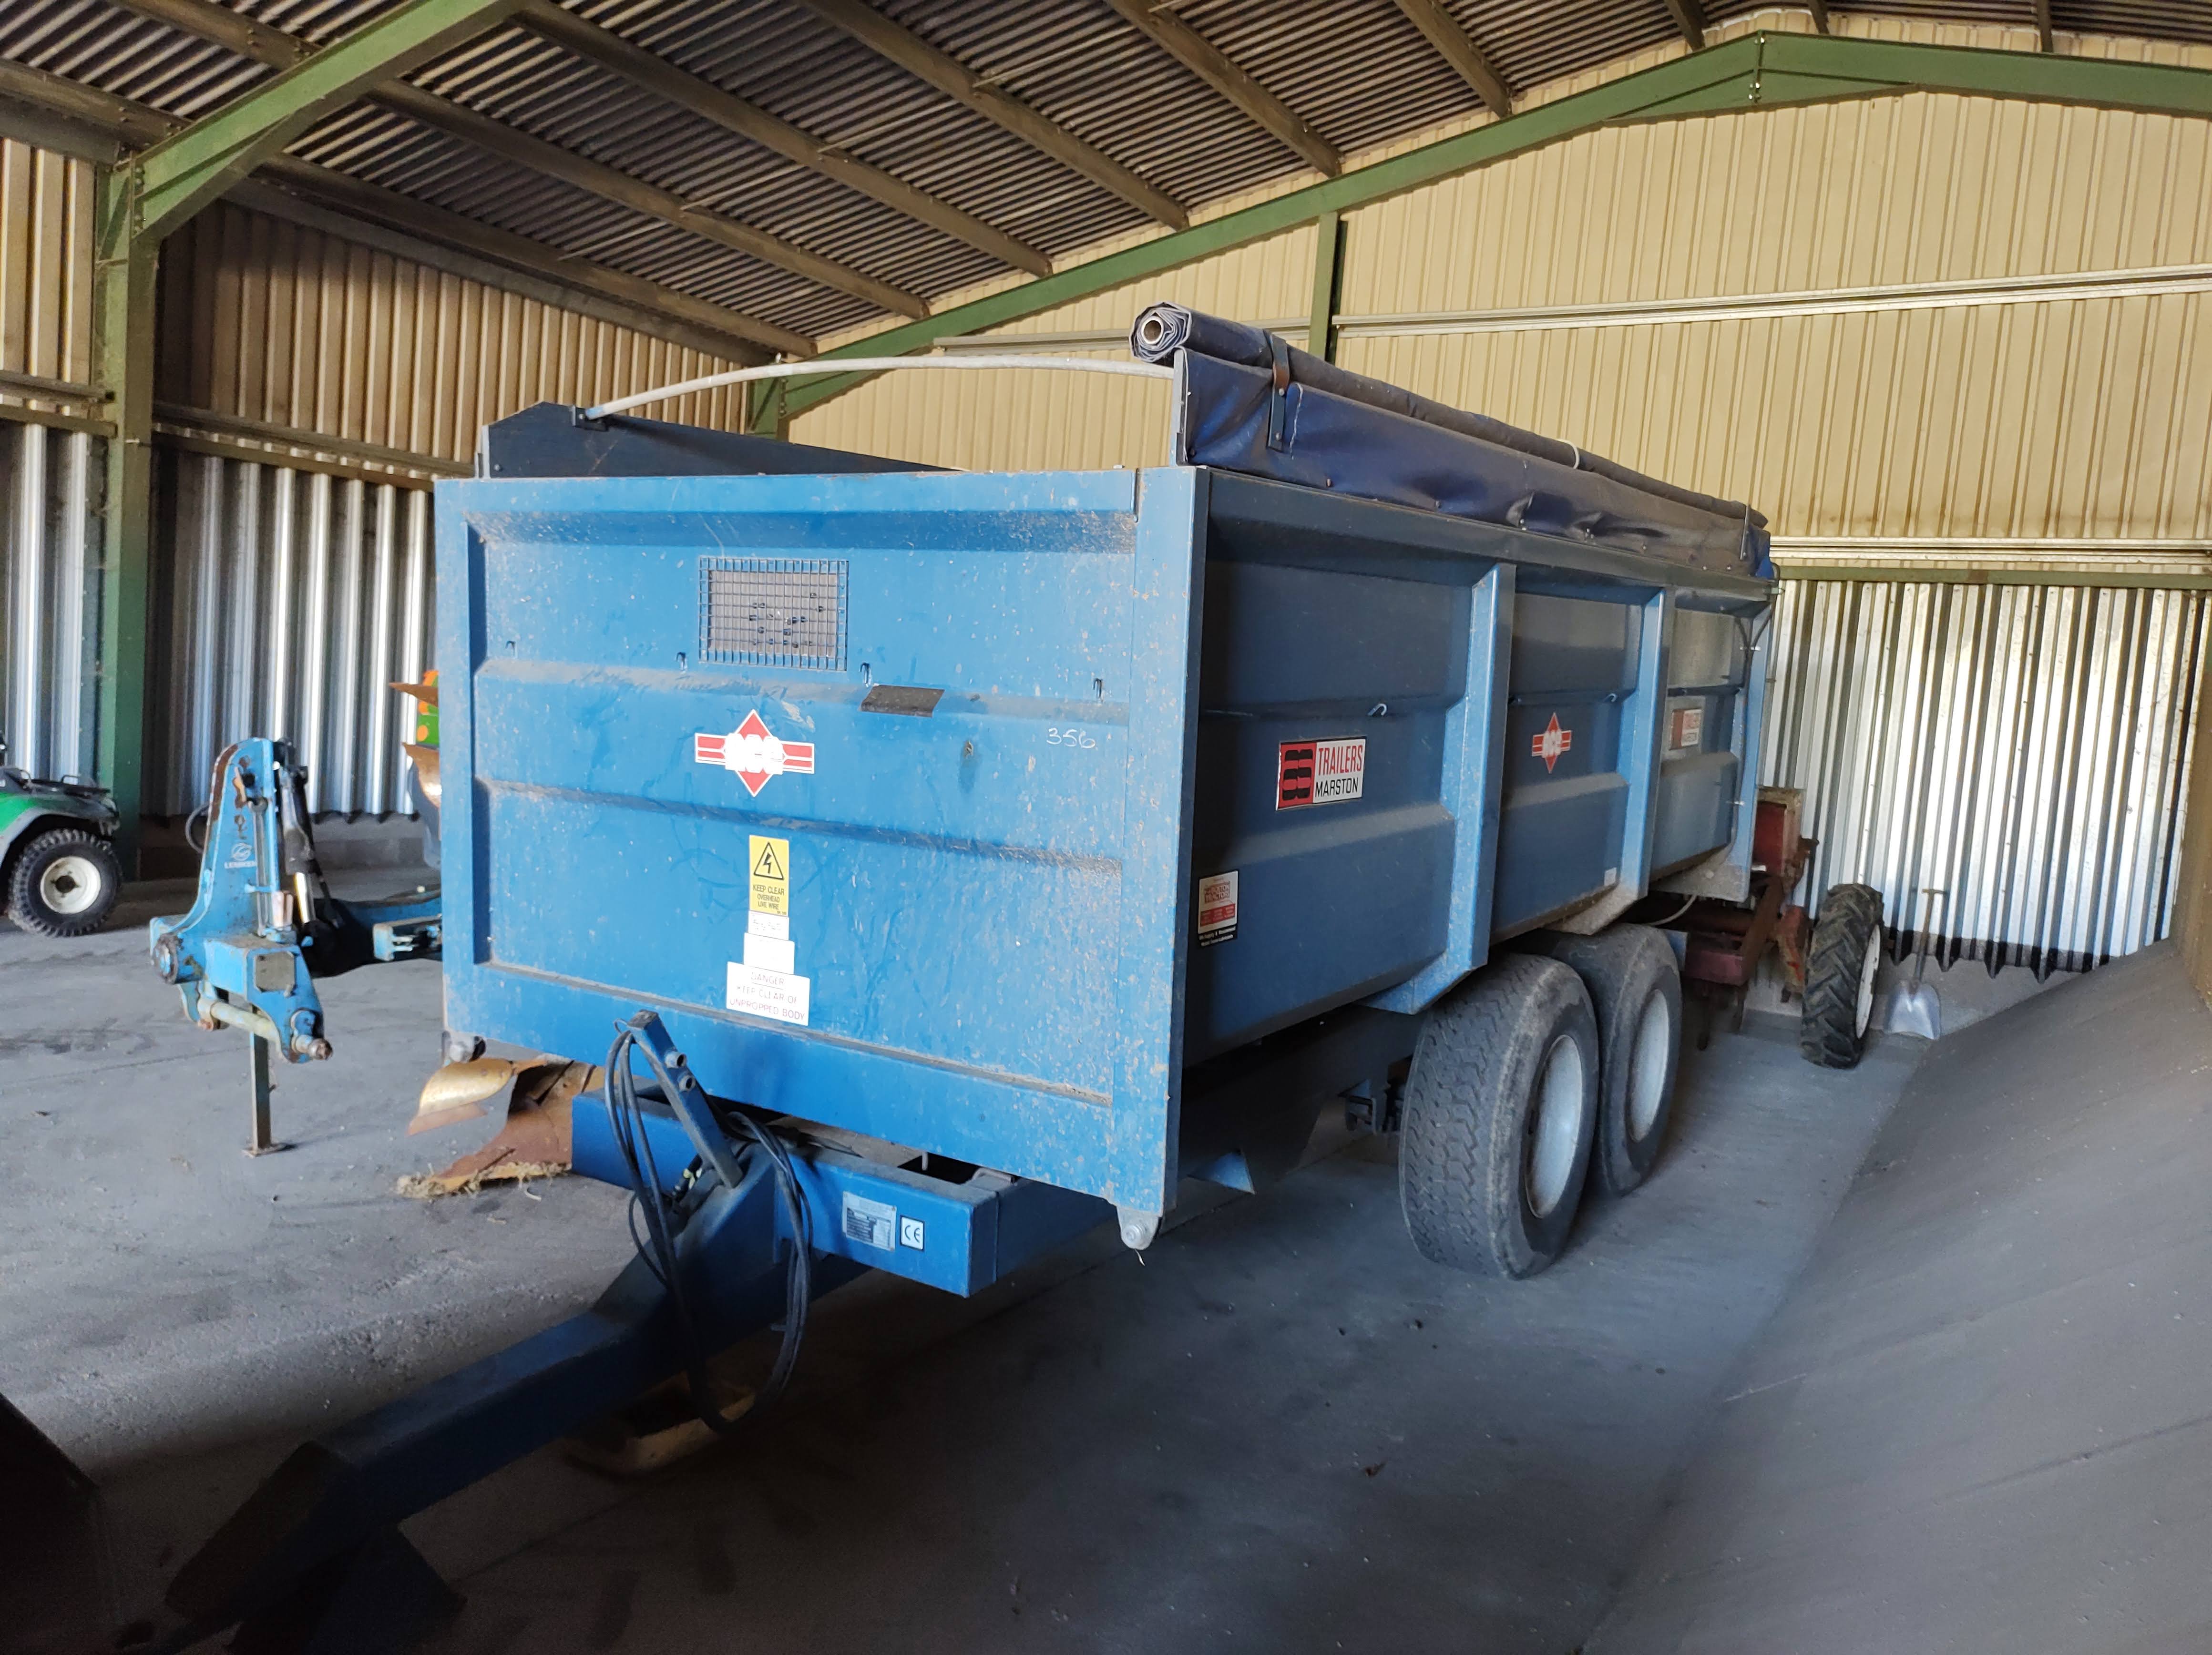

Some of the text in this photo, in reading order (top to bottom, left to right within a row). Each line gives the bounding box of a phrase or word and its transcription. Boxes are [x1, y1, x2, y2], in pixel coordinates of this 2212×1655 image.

[1046, 727, 1096, 748] 356
[1319, 745, 1363, 776] TRAILERS
[1315, 777, 1358, 797] MARSTON
[753, 884, 785, 895] KEEP CLEAR
[751, 972, 785, 985] DANGER
[730, 999, 805, 1021] UNPROPPED BODY
[904, 1224, 921, 1243] CE
